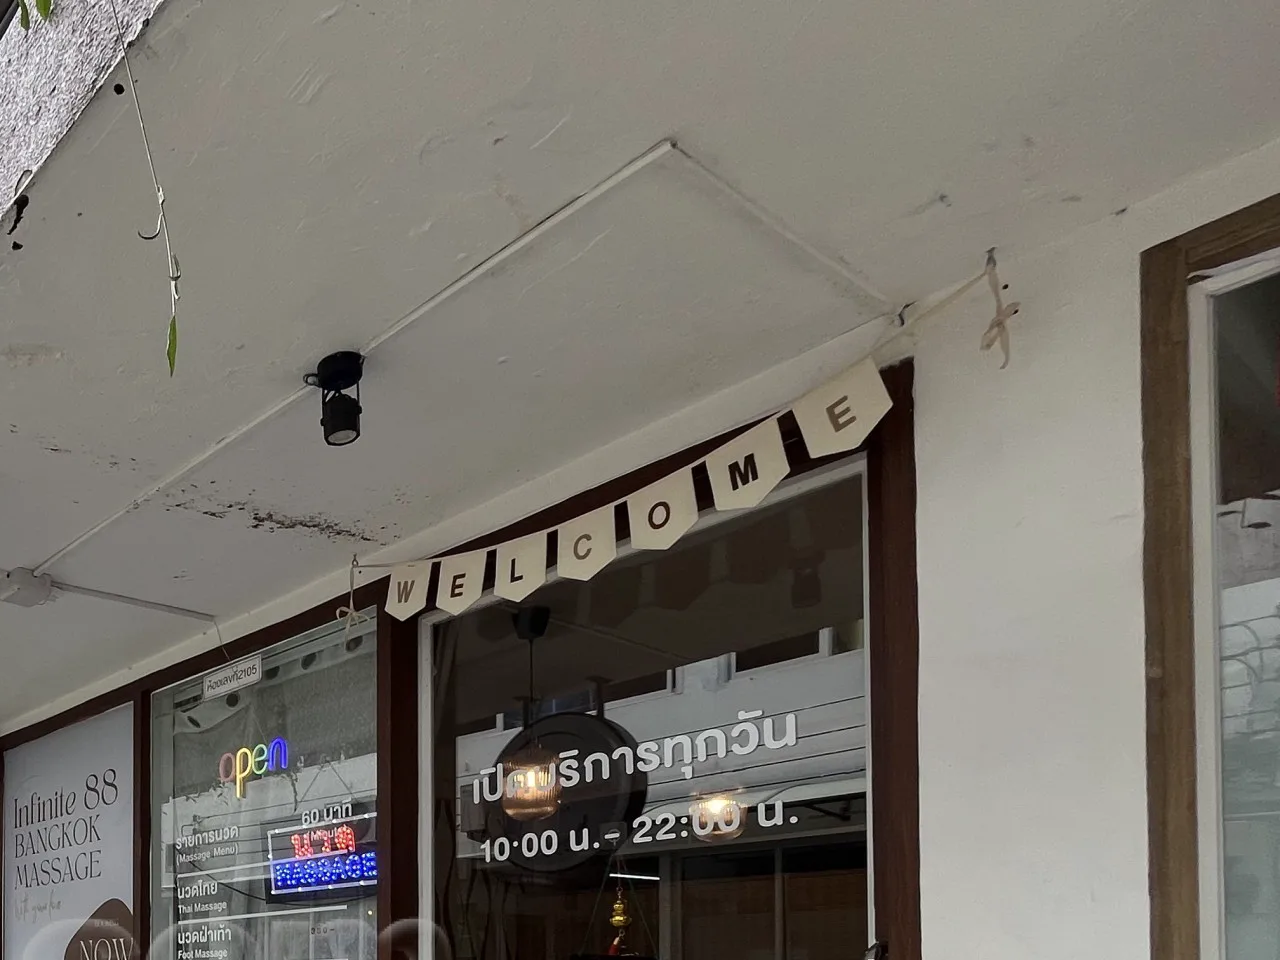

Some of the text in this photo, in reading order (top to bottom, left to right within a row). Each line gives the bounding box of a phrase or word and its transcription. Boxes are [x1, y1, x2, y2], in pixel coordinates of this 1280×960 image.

[218, 735, 289, 798] open
[472, 710, 798, 805] เปิดบริการทุกวัน
[13, 768, 119, 829] Infinite 88
[301, 798, 353, 825] 60 นาที
[15, 813, 102, 859] BANGKOK
[175, 825, 239, 850] รายการนวด
[632, 803, 741, 844] 22:00
[757, 800, 799, 828] น.
[14, 849, 102, 890] MASSAGE
[176, 842, 239, 866] (Massage Menu)
[275, 851, 377, 887] MASSAGE
[177, 879, 218, 899] นวดไทย
[178, 901, 227, 914] Thai Massage
[177, 925, 232, 944] นวดฝ่าเท้า
[178, 948, 228, 960] Foot Massage
